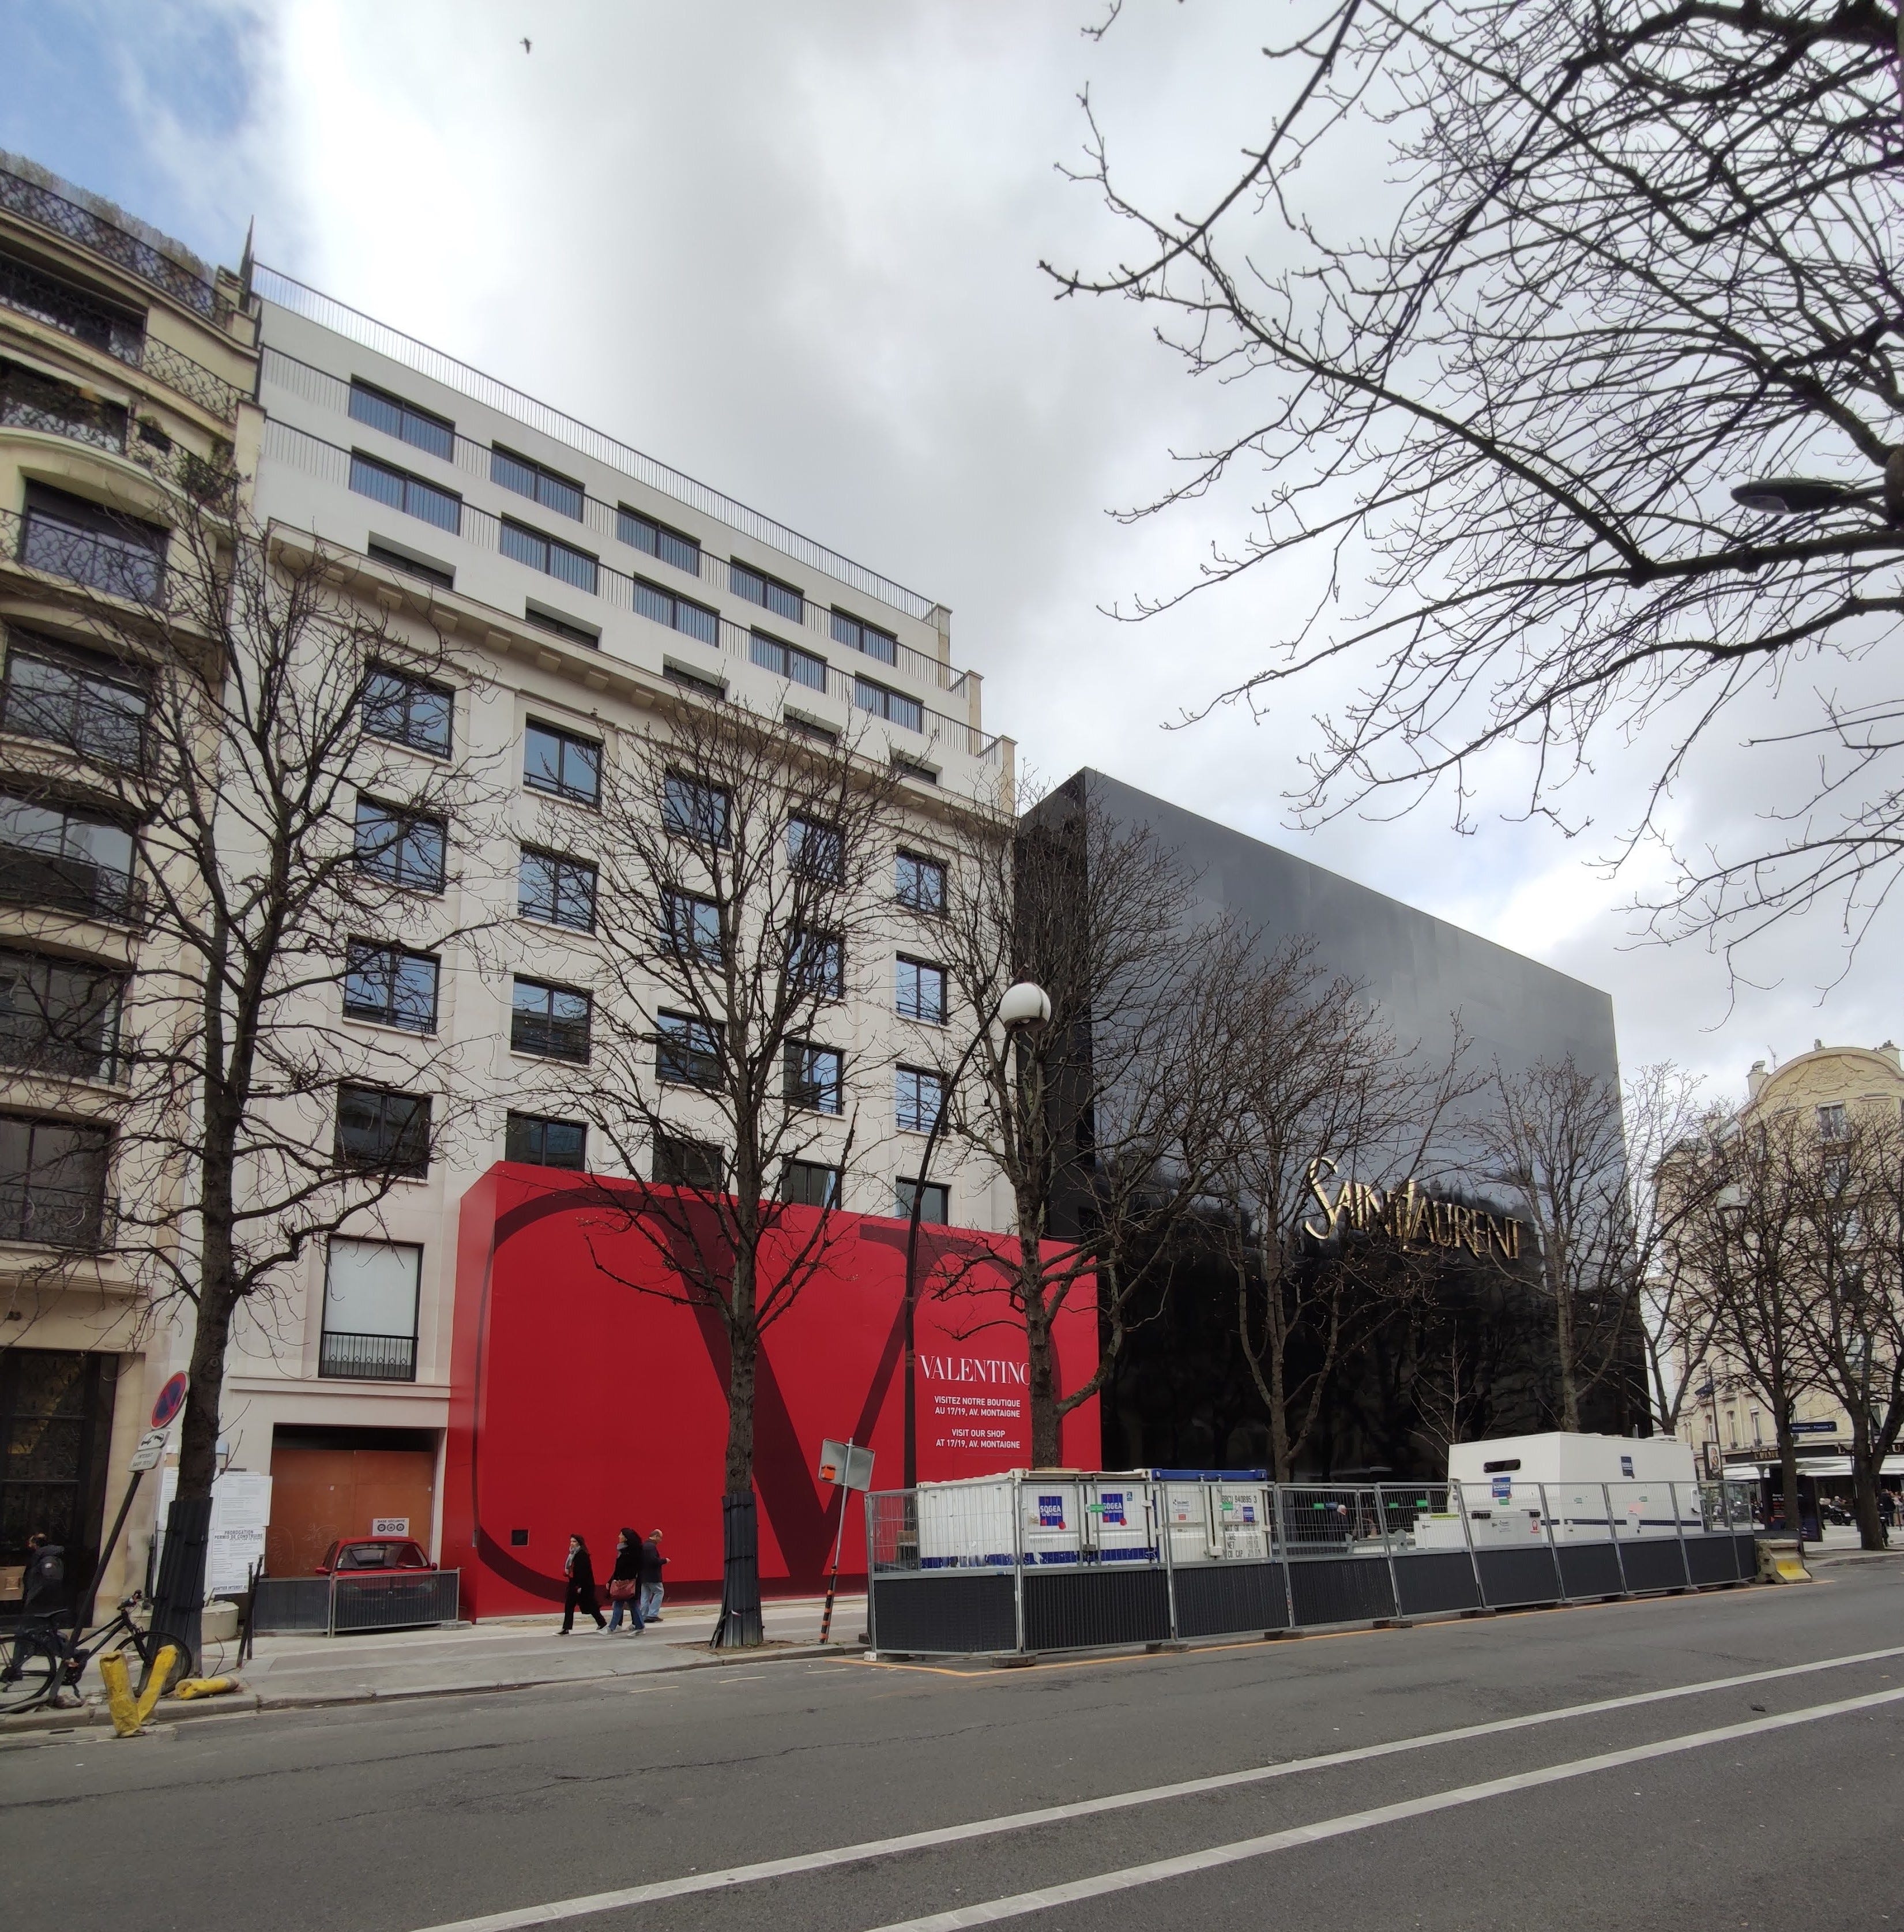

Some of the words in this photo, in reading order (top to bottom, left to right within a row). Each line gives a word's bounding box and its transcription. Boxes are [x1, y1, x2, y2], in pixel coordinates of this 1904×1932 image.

[934, 1396, 961, 1405] VISITEZ
[962, 1397, 985, 1406] NOTRE
[987, 1398, 1021, 1408] BOUTIQUE
[935, 1407, 945, 1415] AU
[947, 1407, 968, 1416] 17/19,
[969, 1408, 979, 1416] AV.
[981, 1409, 1021, 1418] MONTAIGNE
[951, 1429, 969, 1437] VISIT
[970, 1429, 985, 1438] OUR
[987, 1430, 1005, 1438] SHOP
[936, 1439, 945, 1447] AT
[947, 1439, 968, 1449] 17/19,
[969, 1440, 979, 1448] AV.
[981, 1440, 1021, 1449] MONTAIGNE
[1254, 1495, 1257, 1503] 3
